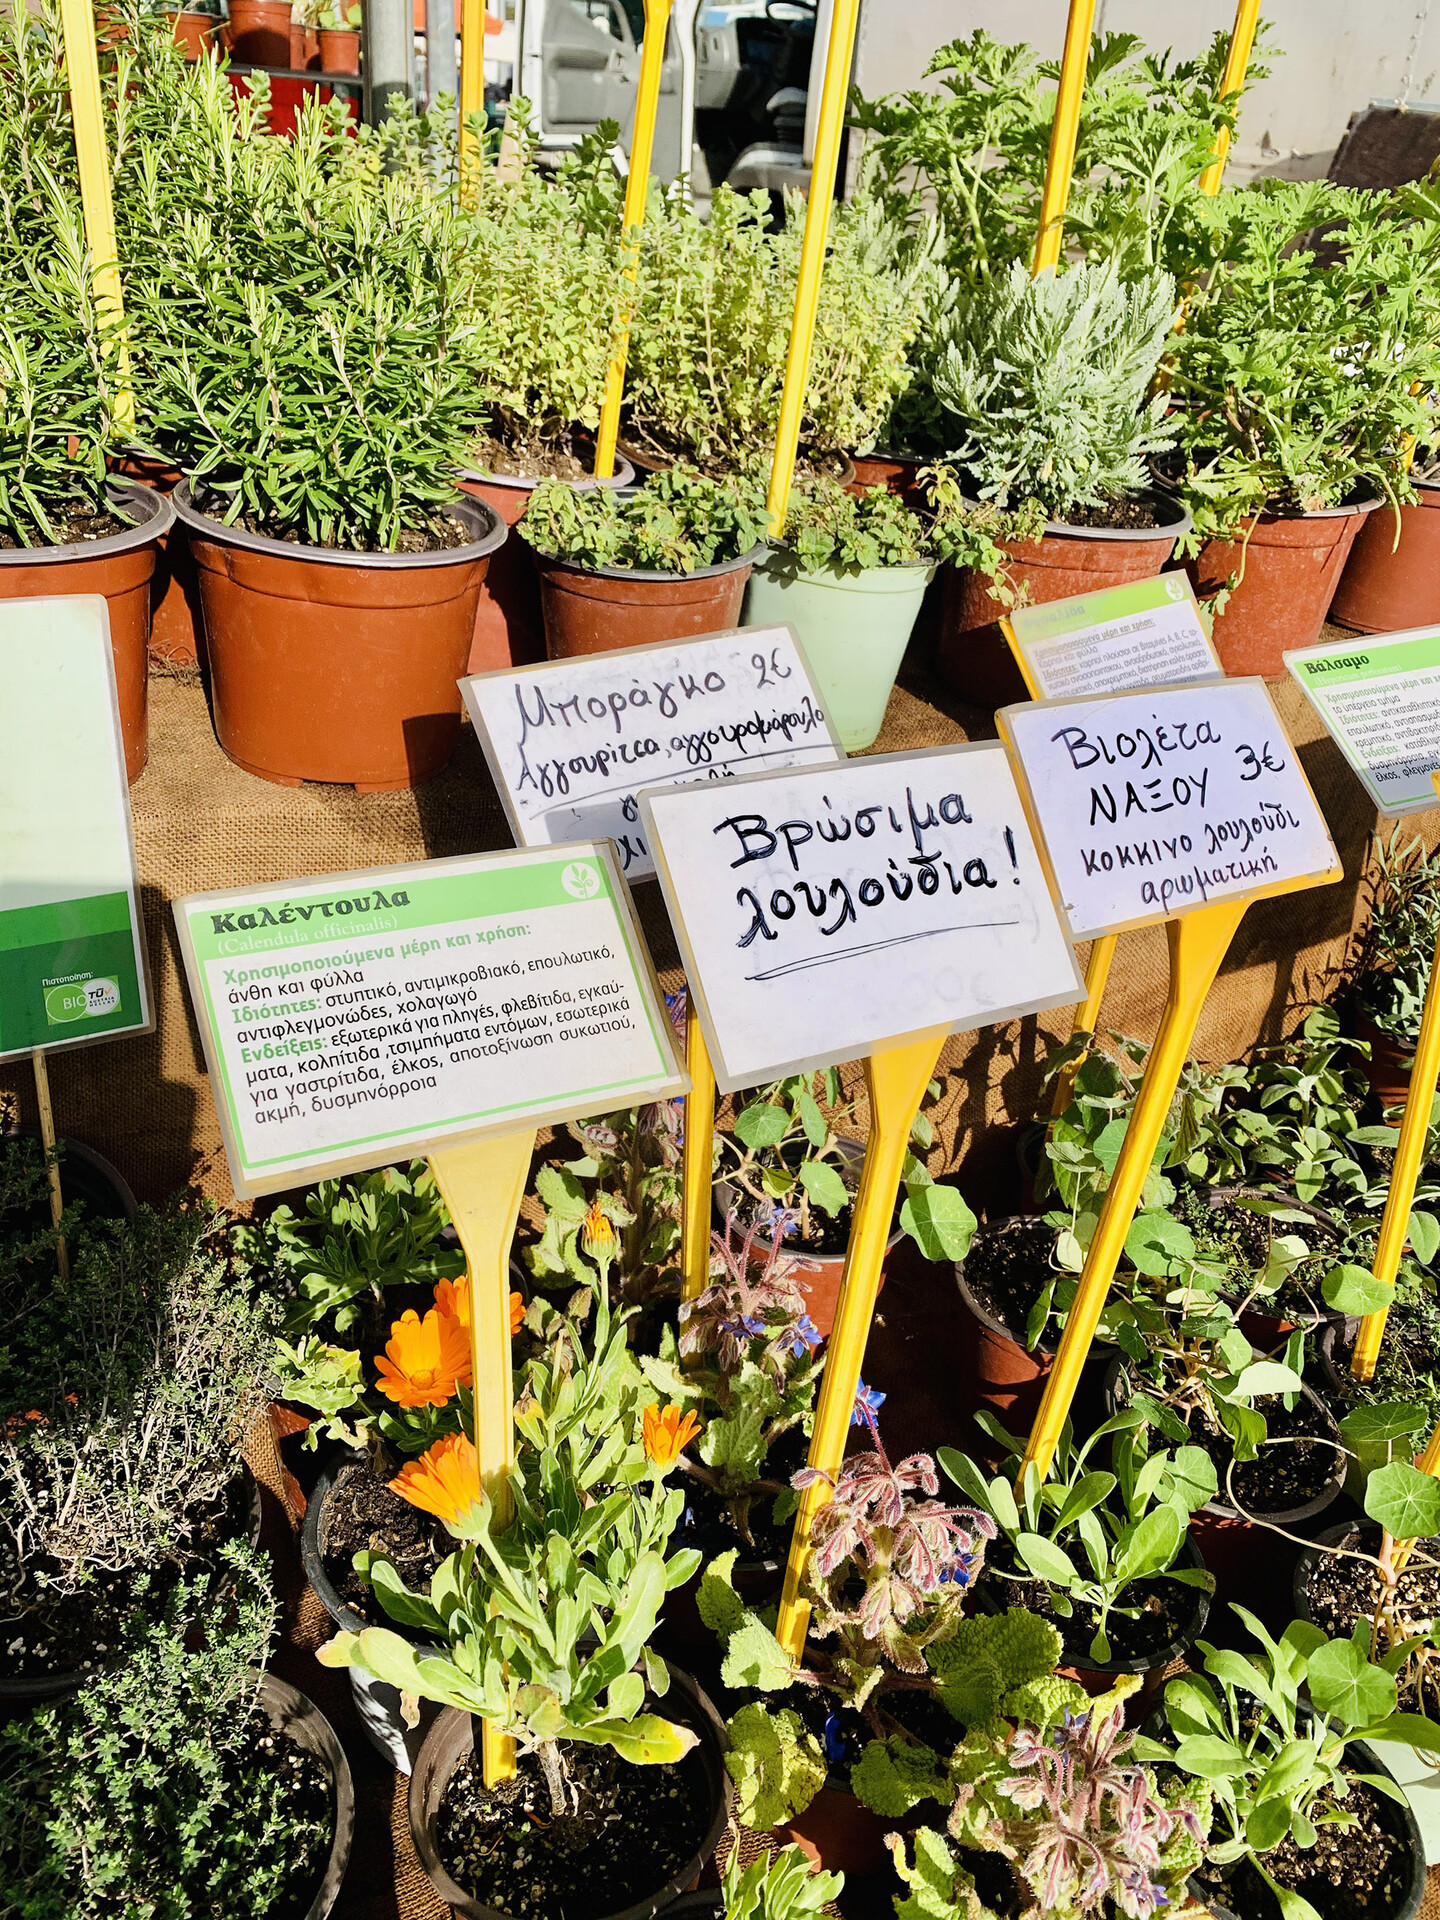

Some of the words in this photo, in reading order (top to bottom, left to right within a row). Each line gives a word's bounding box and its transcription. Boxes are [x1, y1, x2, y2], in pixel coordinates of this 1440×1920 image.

[1119, 625, 1130, 633] και
[1303, 655, 1369, 674] Βάλσαμο
[1399, 678, 1420, 691] μέρη
[1419, 676, 1433, 685] και
[515, 670, 726, 744] Μποράγκο
[1332, 706, 1343, 714] το
[1376, 695, 1401, 706] τμήμα
[1051, 714, 1221, 769] Βιολέτα
[1090, 767, 1208, 826] ΝΑΞΟΥ
[1235, 741, 1286, 780] 3€
[1374, 771, 1401, 782] έλκος,
[713, 787, 972, 870] Βρώσιμα
[1204, 801, 1300, 854] λουλούδι
[1141, 846, 1278, 915] αρωματική
[210, 890, 411, 934] Καλέντουλα
[217, 927, 311, 954] (Calendula
[314, 913, 399, 940] officinalis)
[42, 971, 94, 987] Πιστοποίηση:
[222, 946, 395, 987] Χρησιμοποιούμενα
[399, 938, 441, 959] μέρη
[445, 934, 472, 948] και
[475, 924, 531, 945] χρήση:
[63, 995, 87, 1010] BIO
[228, 984, 272, 1004] άνθη
[277, 981, 304, 996] και
[310, 969, 364, 993] φύλλα
[231, 998, 322, 1024] Ιδιότητες:
[325, 981, 401, 1007] στυπτικό,
[404, 960, 525, 993] αντιμικροβιακό,
[527, 944, 614, 971] επουλωτικό,
[237, 1004, 392, 1043] αντιφλεγμονώδες,
[396, 986, 477, 1014] χολαγωγό
[240, 1037, 328, 1063] Ενδείξεις:
[331, 1017, 412, 1047] εξωτερικά
[414, 1016, 439, 1034] για
[442, 1003, 498, 1025] πληγές,
[501, 989, 576, 1017] φλεβίτιδα,
[578, 979, 624, 1002] εγκαύ-
[245, 1065, 293, 1087] ματα,
[297, 1045, 380, 1073] κολπίτιδα
[484, 1015, 552, 1041] εντόμων,
[555, 996, 630, 1023] εσωτερικά
[249, 1087, 278, 1107] για
[284, 1065, 385, 1100] γαστρίτιδα,
[391, 1055, 443, 1075] έλκος,
[449, 1033, 553, 1063] αποτοξίνωση
[559, 1015, 635, 1041] συκωτιού,
[255, 1101, 306, 1124] ακμή,
[311, 1076, 437, 1112] δυσμηνόρροια
